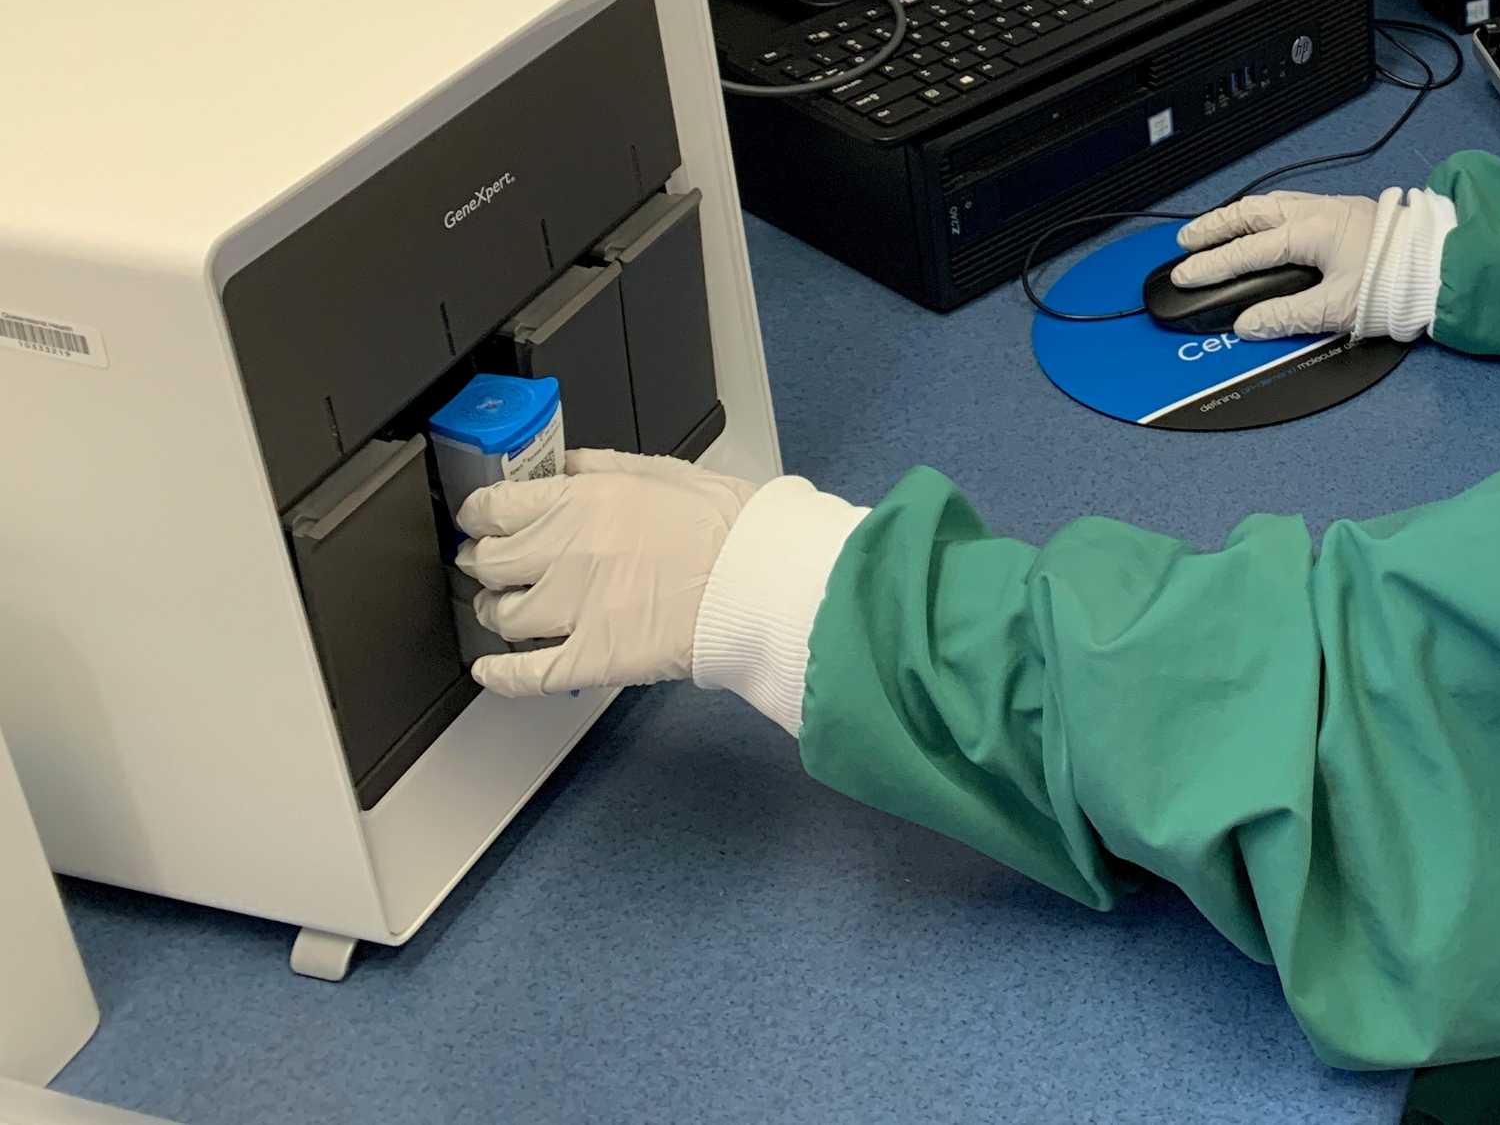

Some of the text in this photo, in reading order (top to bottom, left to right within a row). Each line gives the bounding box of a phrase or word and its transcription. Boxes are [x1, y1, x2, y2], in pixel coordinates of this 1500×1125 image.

[444, 172, 512, 228] GeneXpert
[1199, 391, 1241, 414] defining
[1297, 346, 1343, 371] molecular
